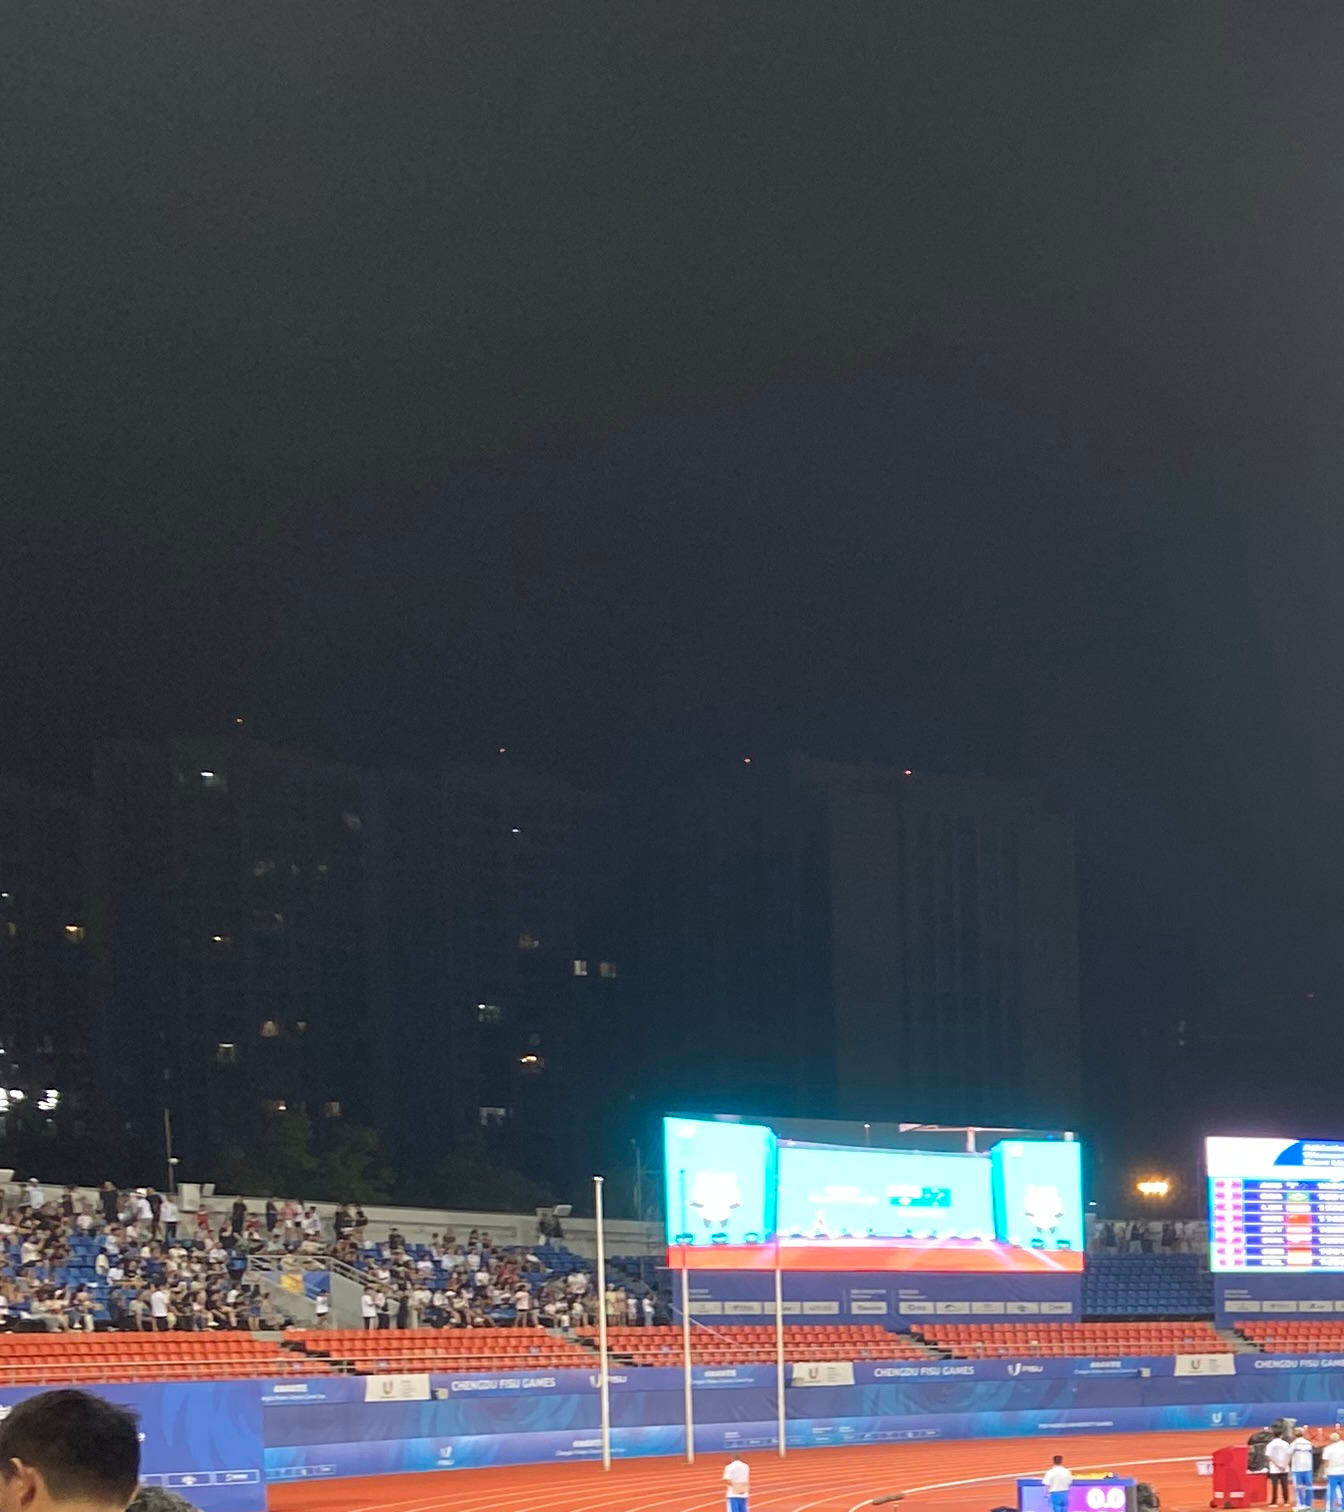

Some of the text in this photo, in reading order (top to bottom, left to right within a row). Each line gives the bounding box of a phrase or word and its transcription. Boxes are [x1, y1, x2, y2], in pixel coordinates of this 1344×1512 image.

[1254, 1359, 1298, 1370] CHENGDU
[1300, 1359, 1320, 1369] FISU
[874, 1365, 975, 1378] CHENGDU FISU GAMES
[452, 1377, 557, 1392] CHENGDU FISU GAMES
